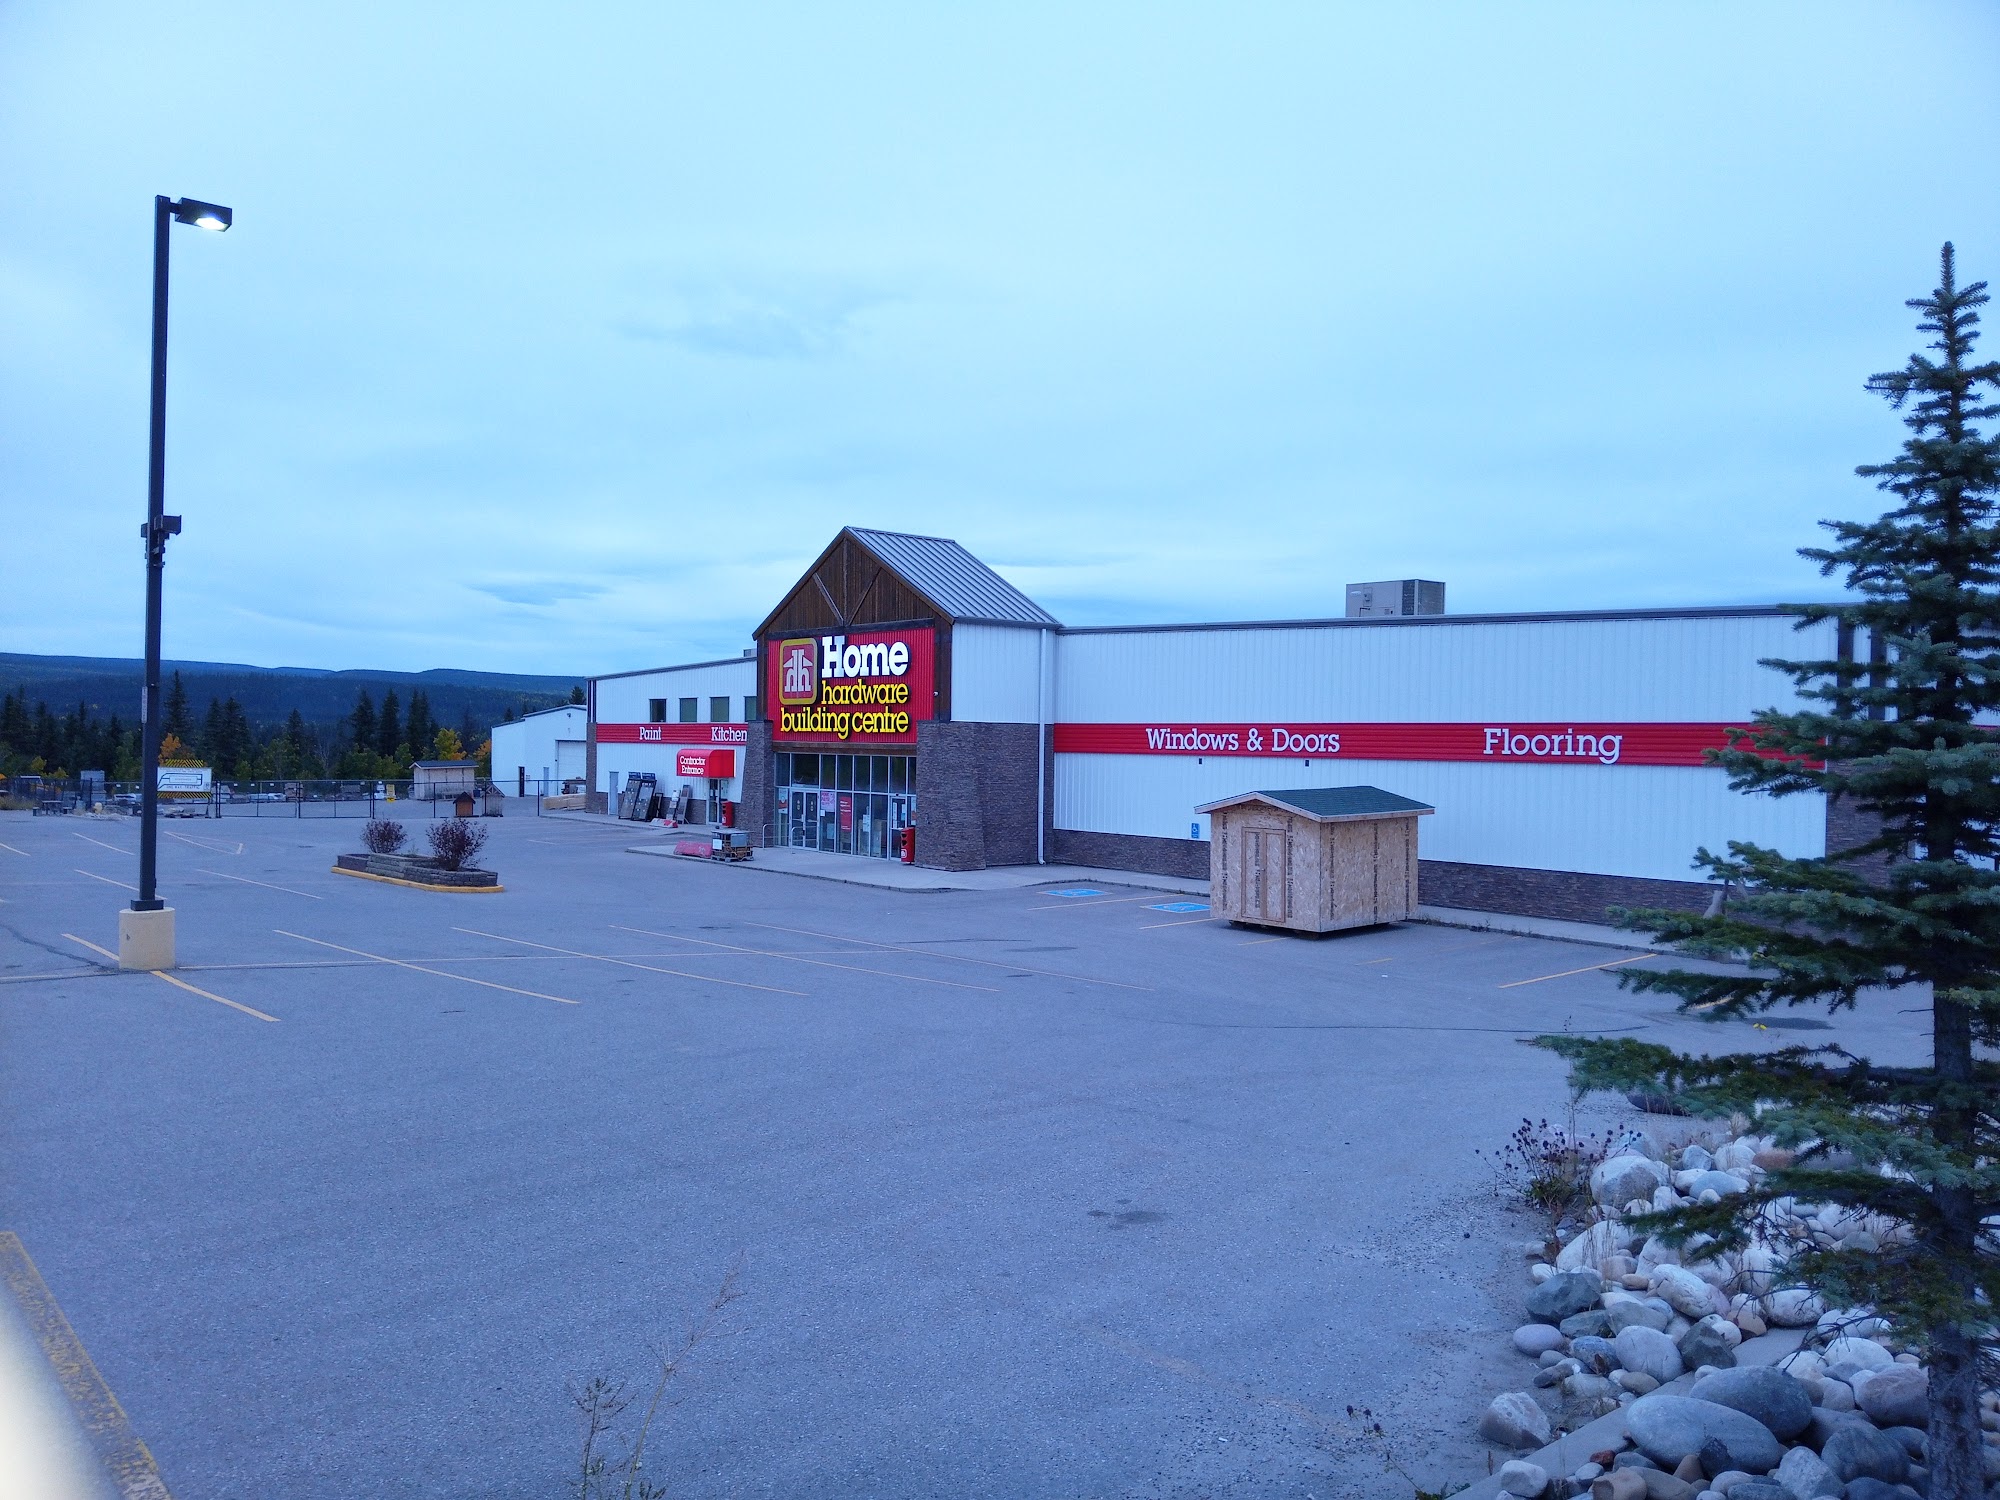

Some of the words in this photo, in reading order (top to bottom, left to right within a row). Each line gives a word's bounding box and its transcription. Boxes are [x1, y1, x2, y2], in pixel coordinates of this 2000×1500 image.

[821, 635, 909, 678] Home
[821, 679, 909, 705] hardware
[639, 726, 662, 741] Paint
[711, 726, 748, 742] Kitchen
[780, 707, 850, 740] building
[852, 706, 909, 733] centre
[1146, 728, 1239, 752] Windows
[1246, 728, 1263, 752] &
[1271, 728, 1341, 754] Doors
[1483, 727, 1623, 765] Flooring
[680, 755, 706, 766] Contractor
[681, 765, 704, 775] Entrance
